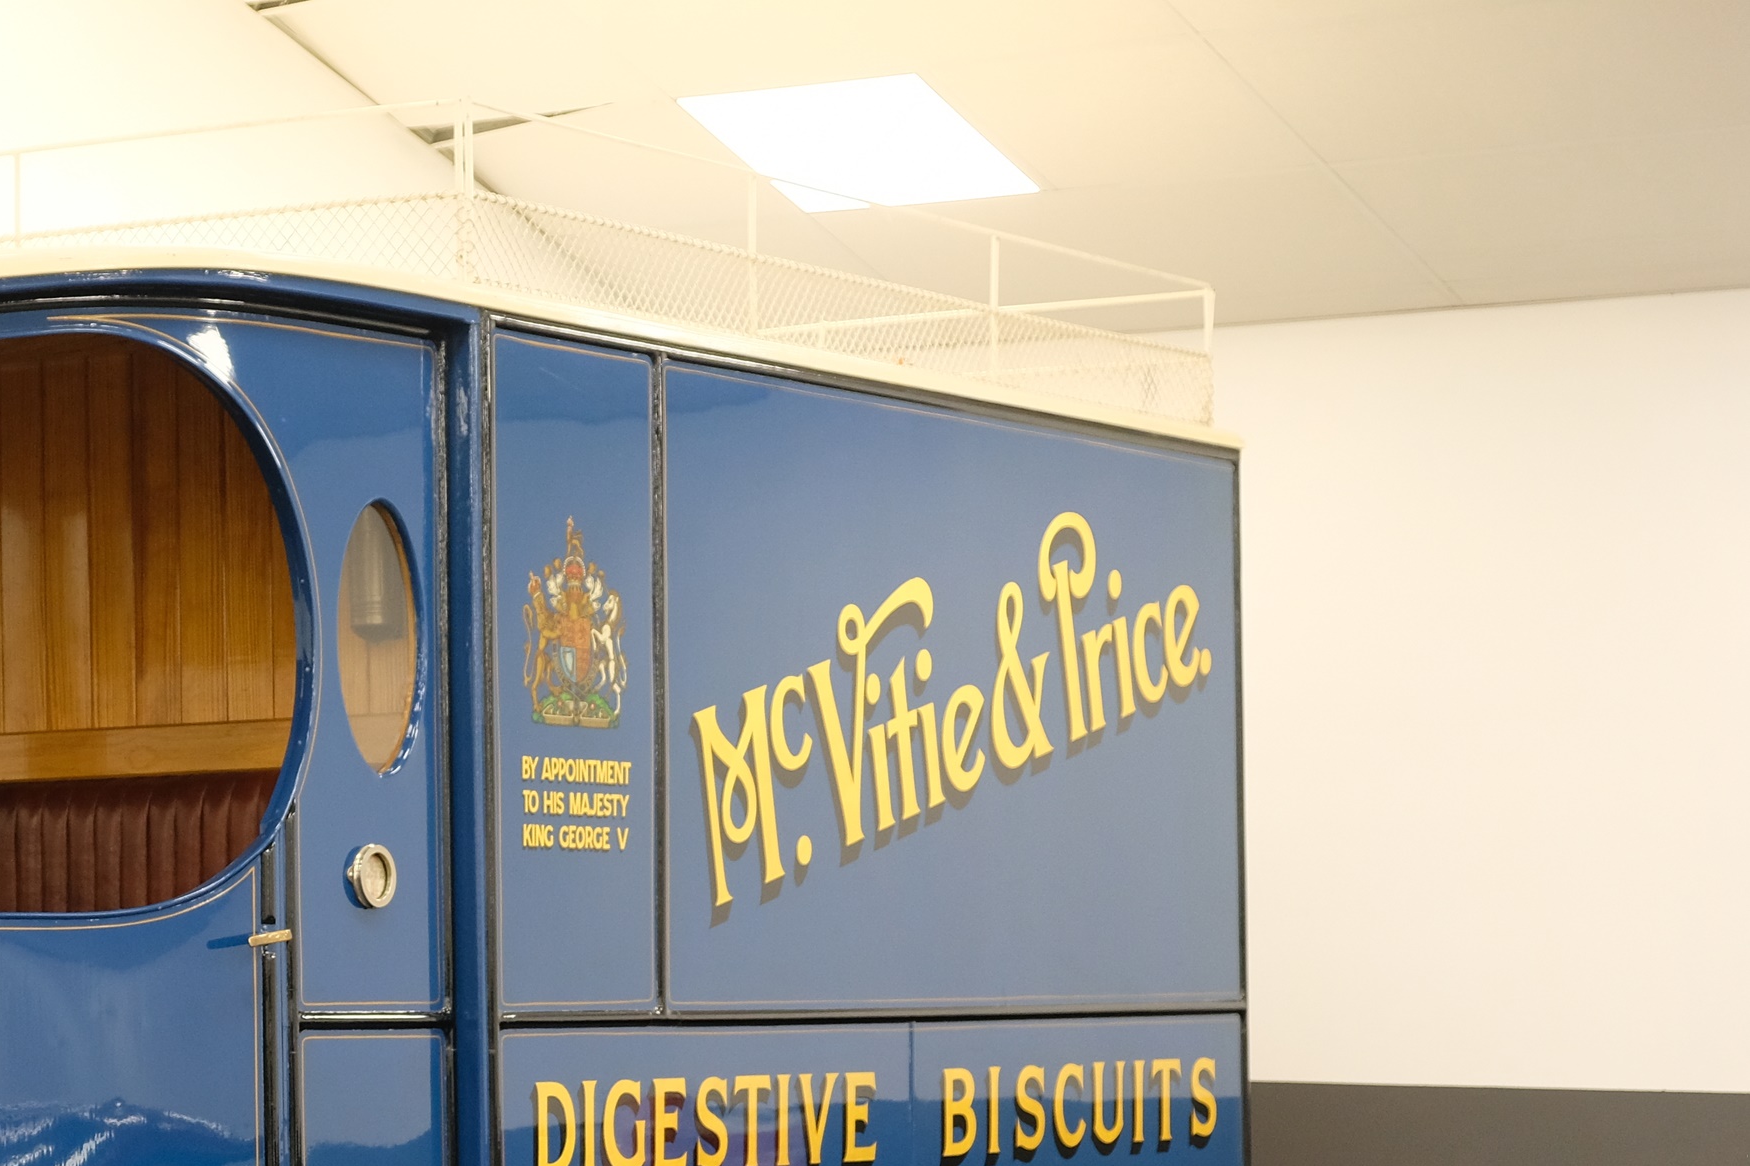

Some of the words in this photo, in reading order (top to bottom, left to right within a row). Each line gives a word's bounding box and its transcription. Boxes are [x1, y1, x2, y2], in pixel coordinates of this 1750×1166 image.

[990, 581, 1054, 769] &
[521, 755, 539, 780] BY
[541, 756, 632, 785] APPOINTMENT
[522, 789, 540, 814] TO
[543, 790, 565, 815] HIS
[569, 791, 630, 817] MAJESTY
[522, 823, 554, 847] KING
[558, 825, 611, 850] GEORGE
[616, 826, 629, 850] V
[942, 1057, 1217, 1158] BISCUITS
